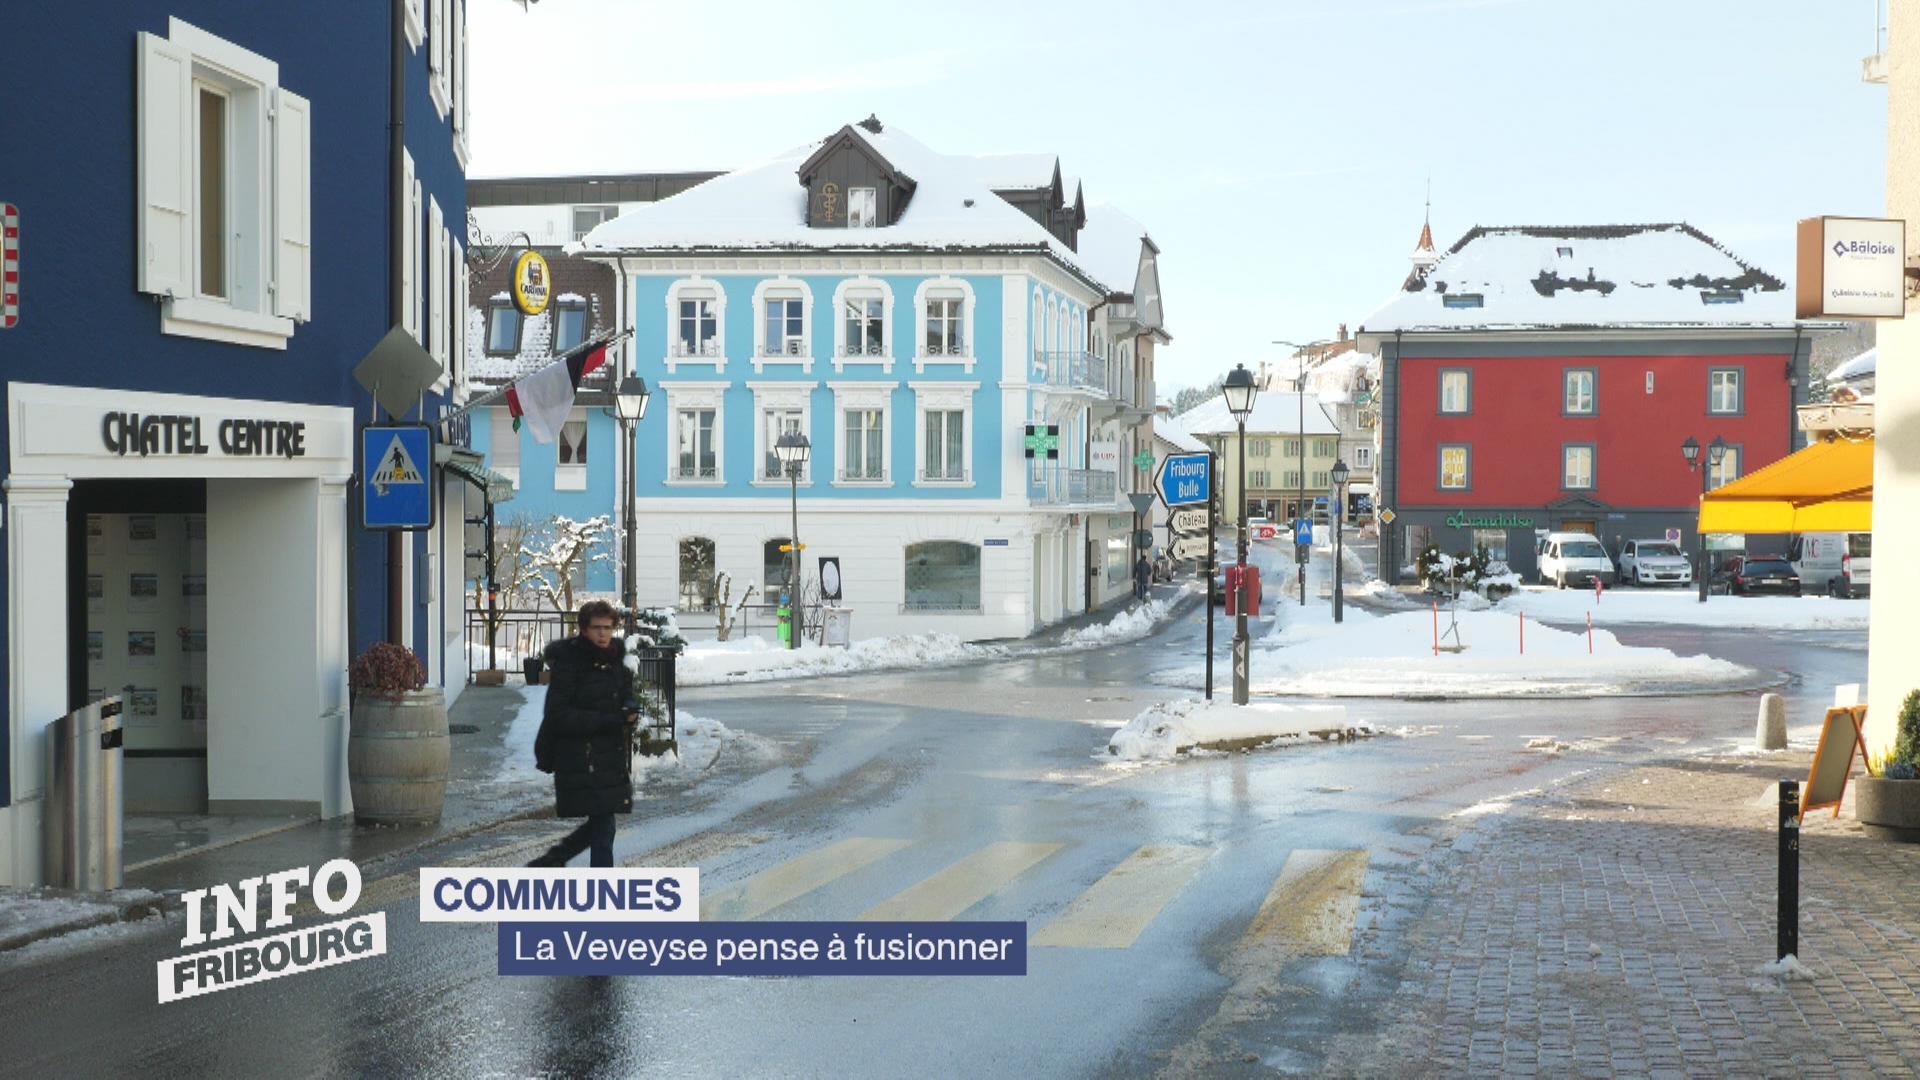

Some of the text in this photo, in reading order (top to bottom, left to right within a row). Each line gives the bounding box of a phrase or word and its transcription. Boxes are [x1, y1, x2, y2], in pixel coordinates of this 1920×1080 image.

[520, 283, 547, 296] CARDINAL
[103, 411, 306, 460] CHATEL CENTRE
[1171, 460, 1204, 479] Fribourg
[1179, 480, 1199, 498] Bulle
[1179, 513, 1206, 527] Château
[1468, 514, 1534, 527] vaudoise
